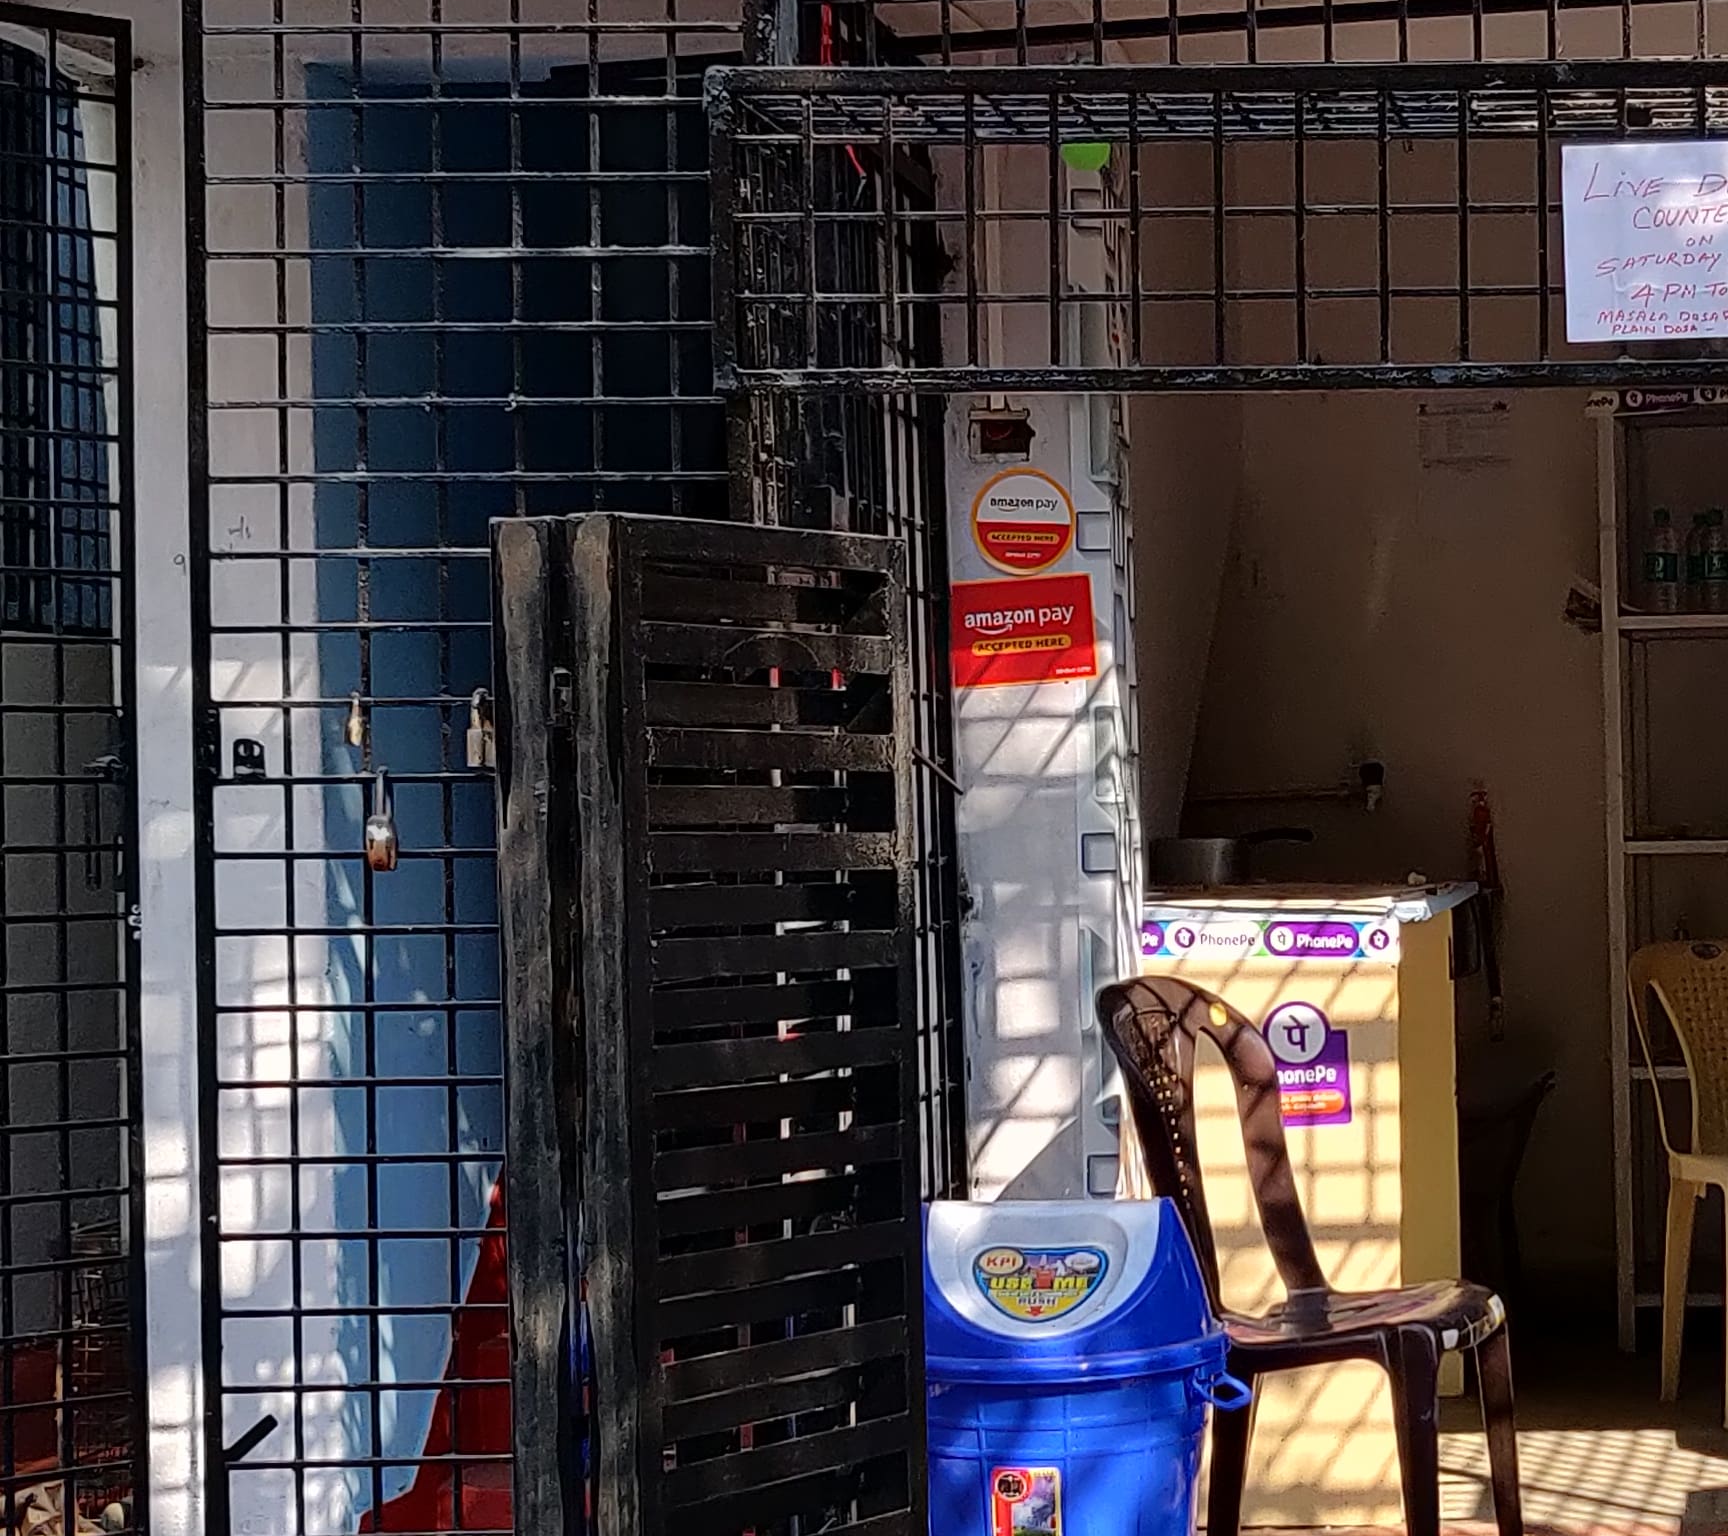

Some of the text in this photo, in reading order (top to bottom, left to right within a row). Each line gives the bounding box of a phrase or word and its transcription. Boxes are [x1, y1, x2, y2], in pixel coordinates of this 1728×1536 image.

[1686, 235, 1714, 247] ON
[1596, 252, 1722, 277] SATURDAY
[1631, 284, 1655, 307] 4
[1663, 284, 1697, 302] PM
[1597, 310, 1668, 325] MASALA
[1680, 311, 1719, 323] DOSA
[1611, 323, 1657, 335] PLAIN
[1664, 323, 1698, 334] DOSA
[990, 497, 1058, 511] amazon pay
[964, 605, 1075, 631] amazon pay
[976, 636, 1065, 652] ACCEPTED HERE
[1200, 933, 1256, 946] PhonePe
[1296, 934, 1355, 950] PhonePe
[986, 1256, 1017, 1267] KPI
[990, 1276, 1033, 1290] USE
